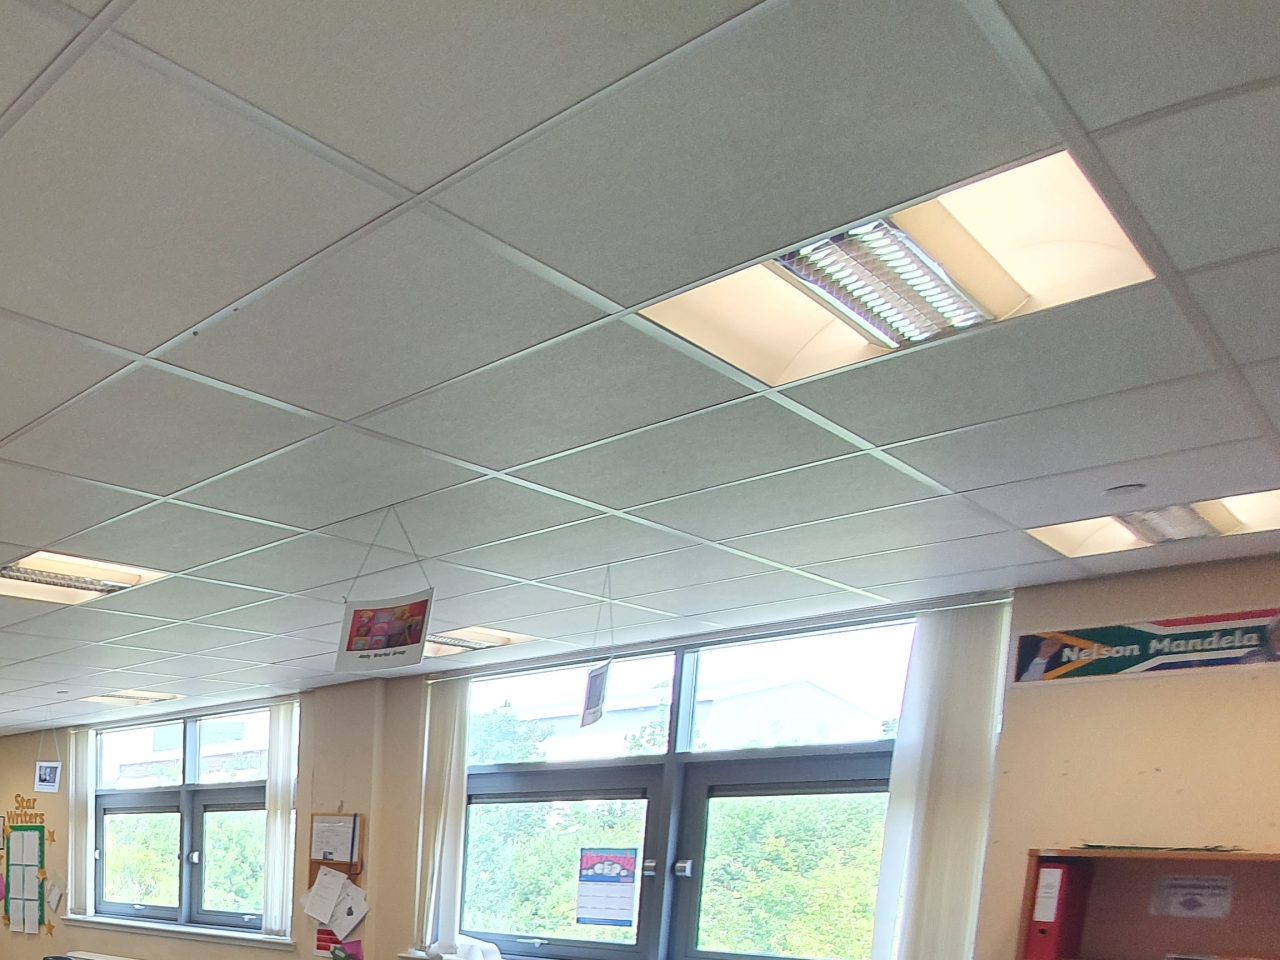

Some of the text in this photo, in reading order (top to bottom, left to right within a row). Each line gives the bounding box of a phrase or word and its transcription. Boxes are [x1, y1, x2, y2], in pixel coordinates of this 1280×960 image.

[1061, 629, 1261, 663] Nelson Mandela
[14, 793, 38, 810] Star
[6, 809, 46, 825] Writers
